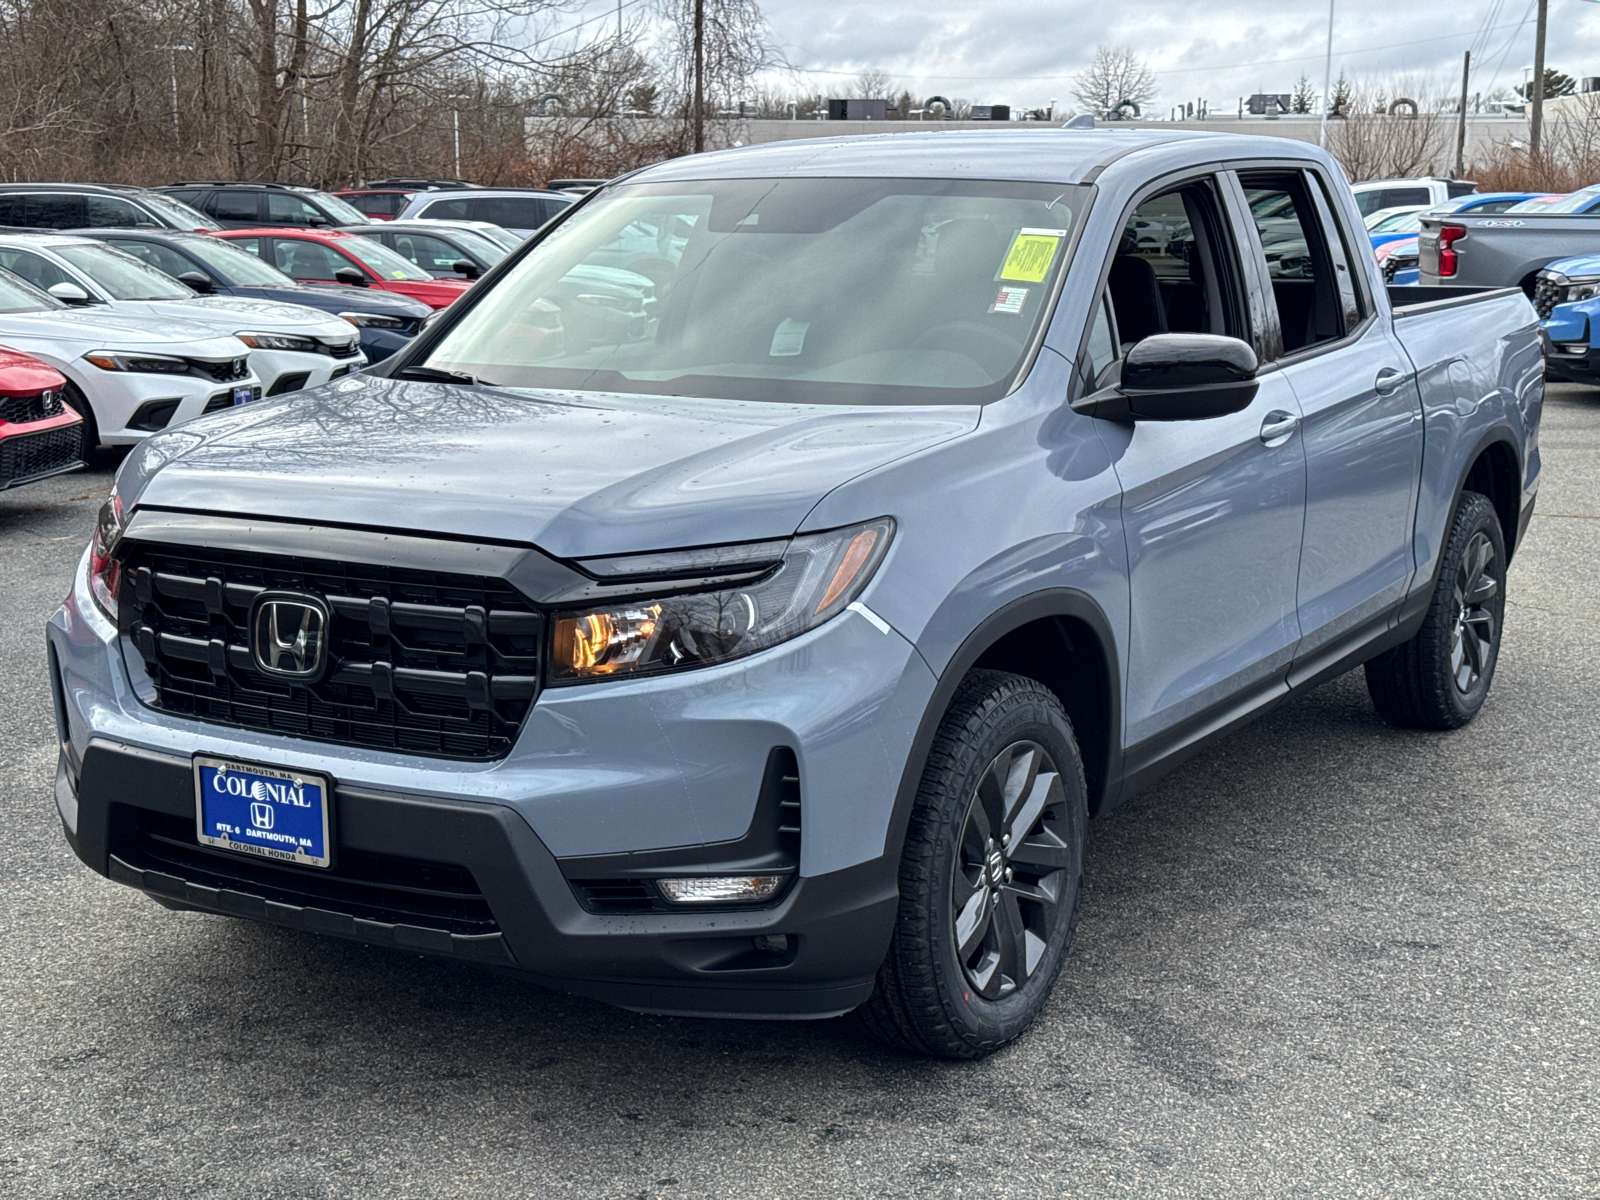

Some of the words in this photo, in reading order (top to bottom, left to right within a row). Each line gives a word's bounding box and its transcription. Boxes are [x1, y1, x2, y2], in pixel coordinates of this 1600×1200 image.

[225, 763, 278, 777] DARTMOUTH,
[279, 772, 293, 780] MA
[213, 774, 311, 808] COLONIAL
[216, 822, 234, 833] RTE.
[234, 826, 241, 835] 6
[245, 828, 298, 846] DARTMOUTH,
[299, 838, 312, 848] MA
[228, 841, 267, 856] COLONIAL
[268, 847, 297, 861] HONDA
